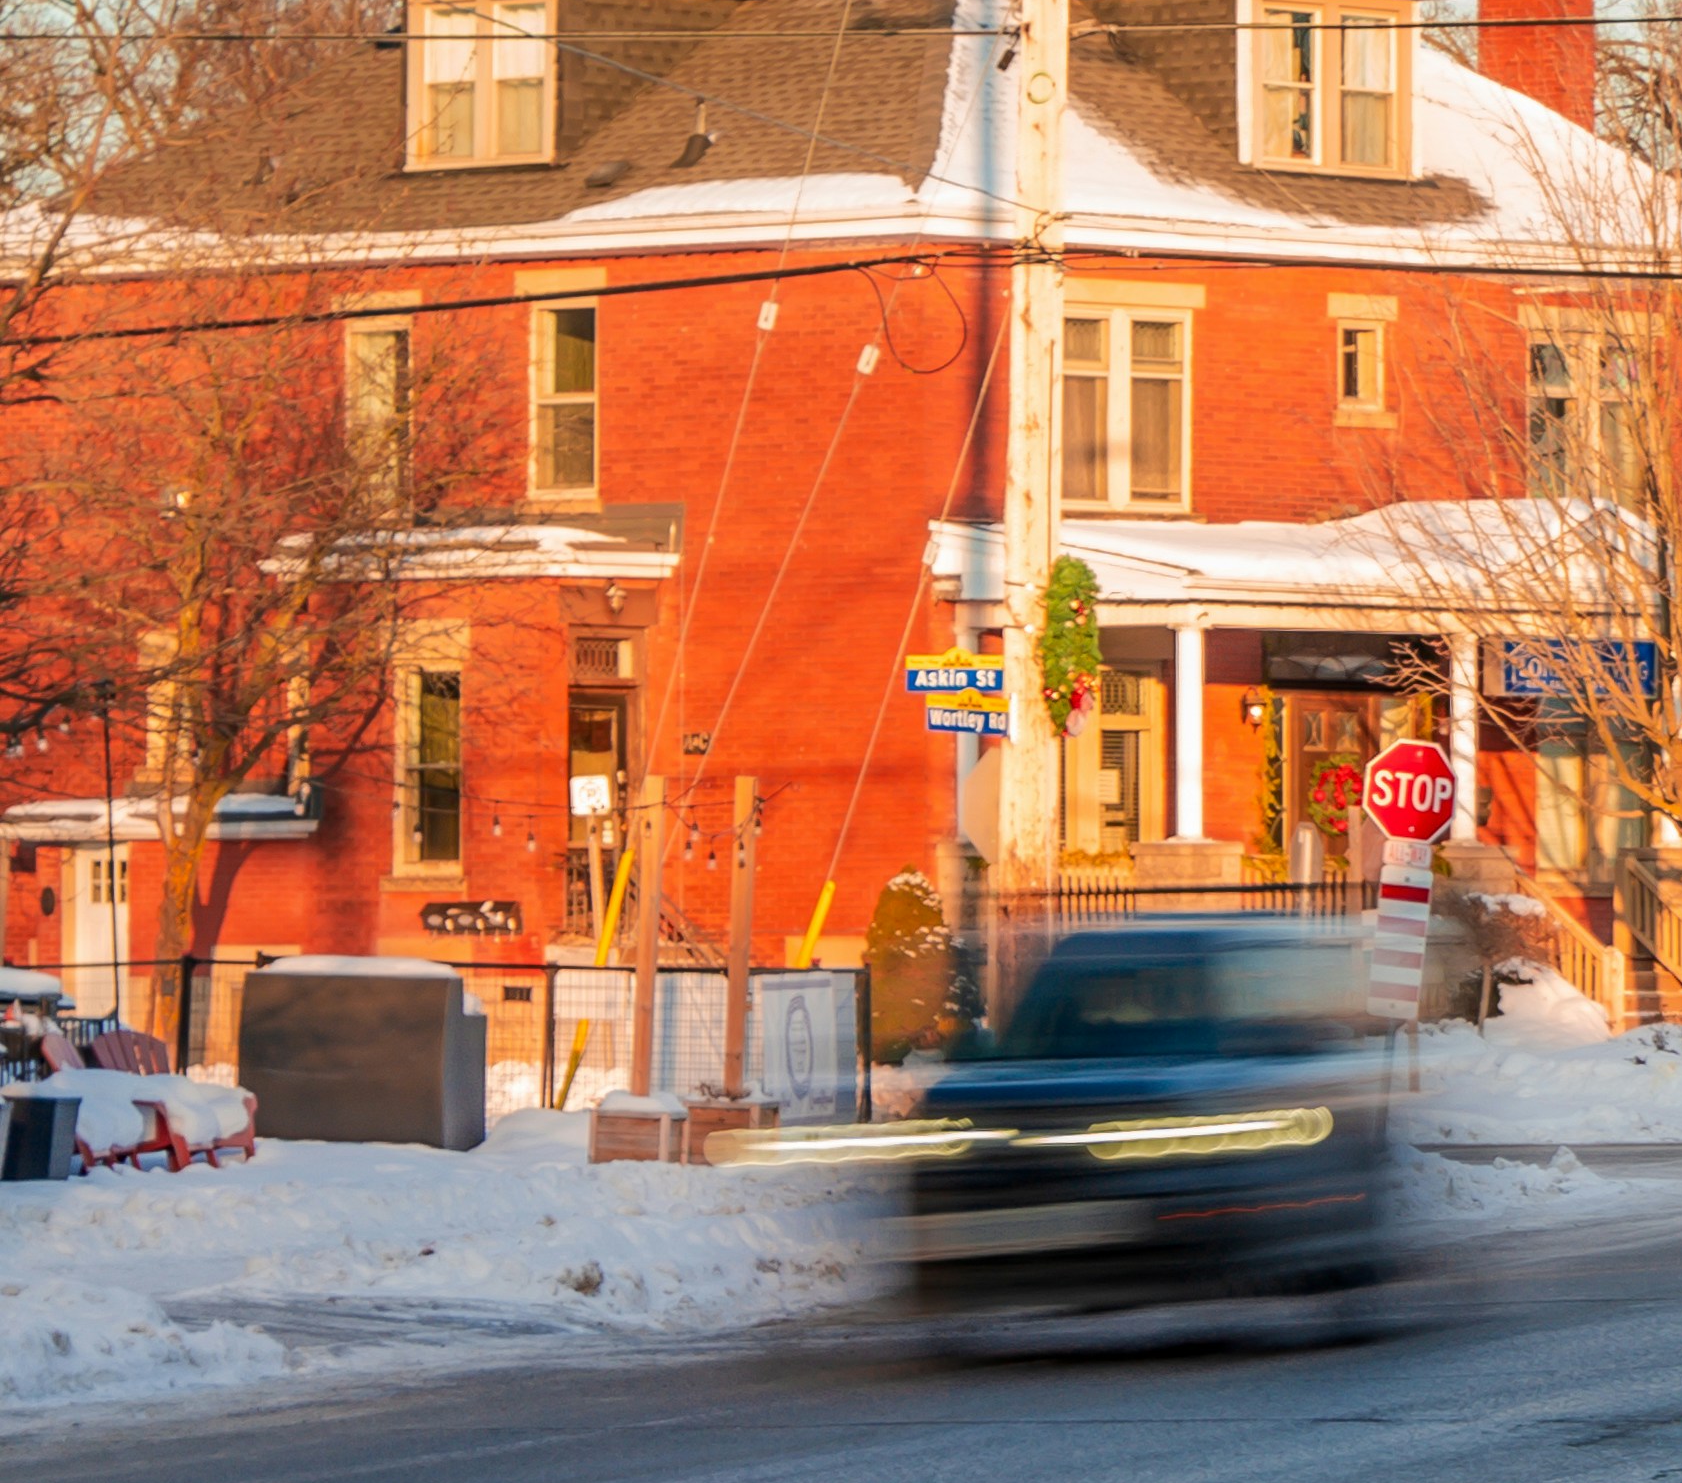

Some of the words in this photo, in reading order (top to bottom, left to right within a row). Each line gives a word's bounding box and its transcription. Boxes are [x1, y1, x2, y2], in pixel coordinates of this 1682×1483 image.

[914, 669, 968, 687] Askin
[975, 669, 997, 688] St
[929, 709, 985, 733] Wortley
[988, 712, 1007, 731] Rd
[1372, 769, 1453, 814] STOP
